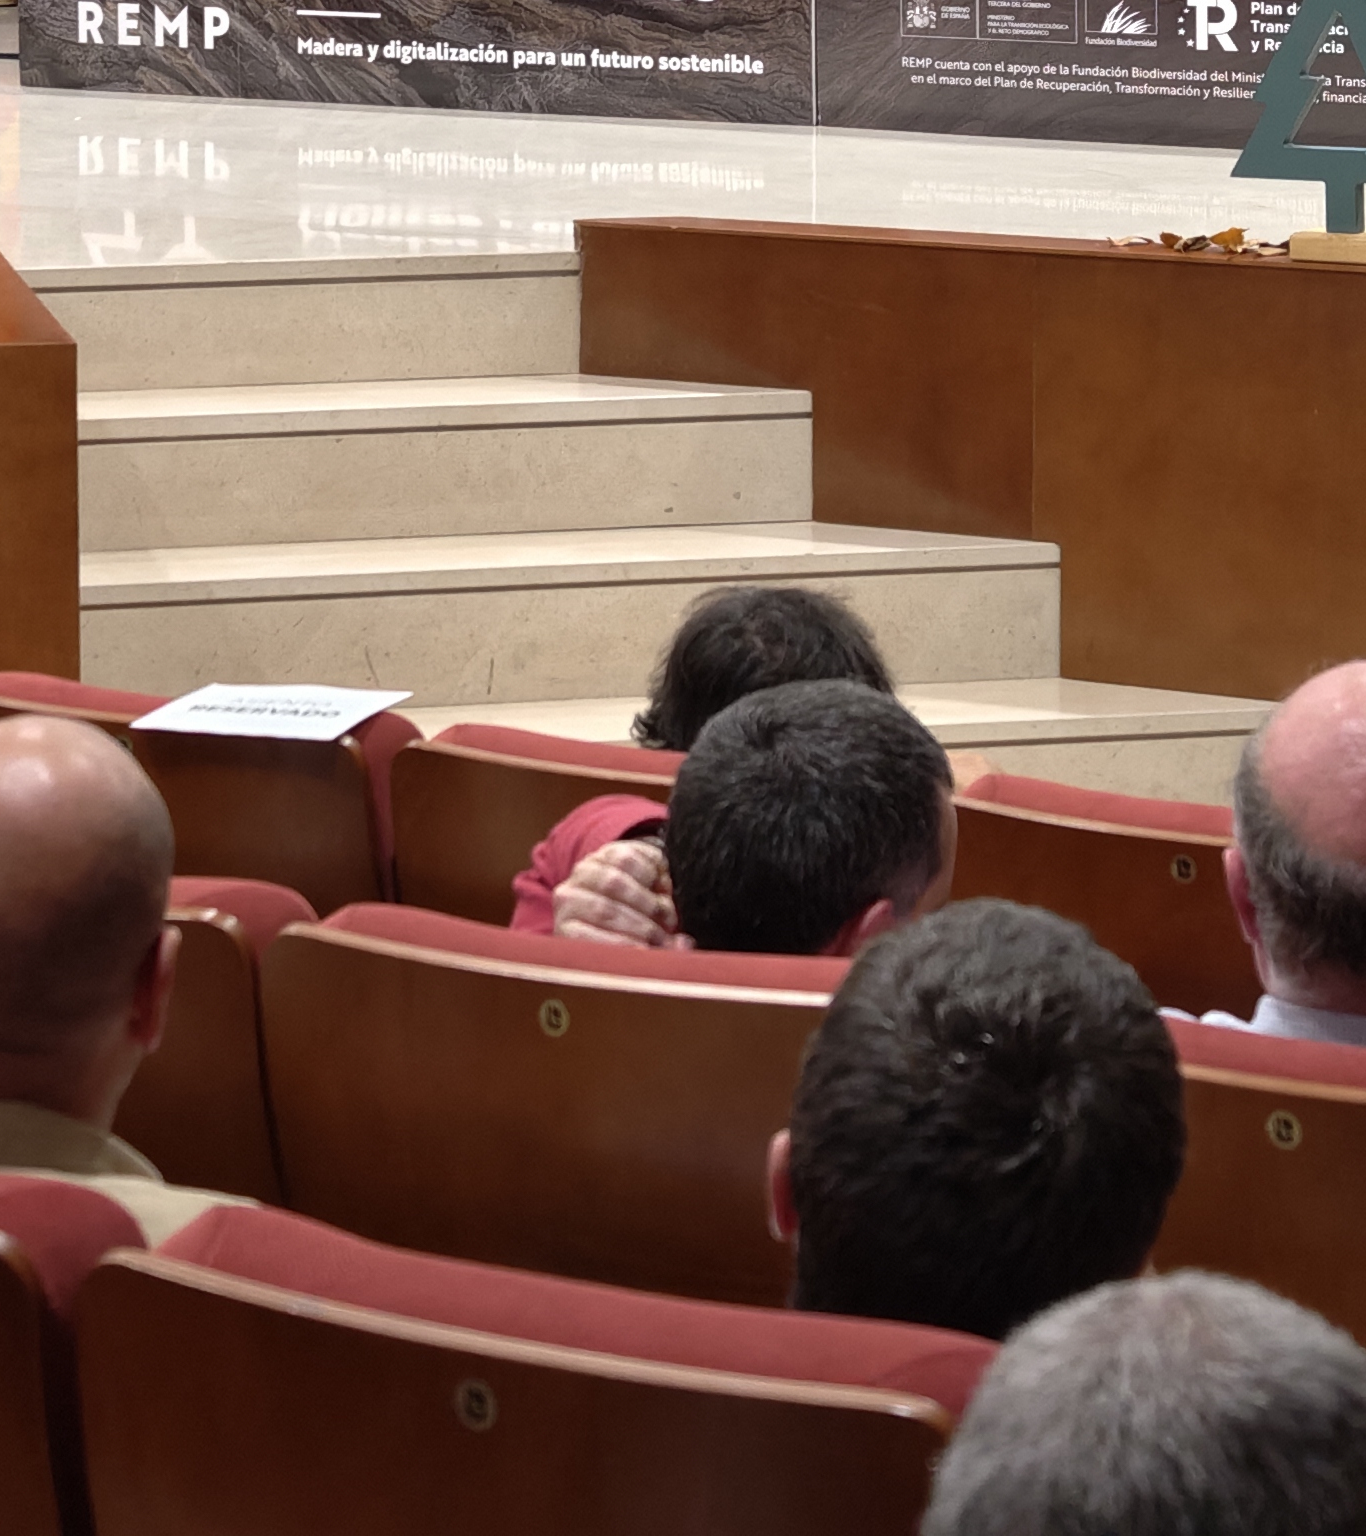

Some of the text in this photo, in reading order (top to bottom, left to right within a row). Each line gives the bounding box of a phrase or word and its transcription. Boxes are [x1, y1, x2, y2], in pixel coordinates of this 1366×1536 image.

[1249, 1, 1283, 16] Plan
[77, 0, 231, 50] REMP
[296, 36, 764, 75] Madera y digitalización para un futuro sostenible
[1250, 40, 1260, 54] y
[901, 56, 932, 69] REMP
[934, 60, 971, 71] cuenta
[972, 61, 992, 72] con
[994, 61, 1005, 73] el
[1007, 64, 1041, 77] apoyo
[1042, 63, 1057, 75] de
[1059, 63, 1070, 75] la
[1072, 64, 1129, 78] Fundación
[1131, 66, 1208, 82] Biodiversidad
[1210, 70, 1229, 83] del
[910, 75, 925, 84] en
[926, 72, 937, 84] el
[939, 76, 972, 87] marco
[974, 74, 992, 87] del
[993, 75, 1017, 88] Plan
[1019, 77, 1034, 89] de
[1035, 78, 1113, 94] Recuperación,
[1115, 81, 1201, 97] Transformación
[1202, 86, 1211, 100] y
[187, 703, 342, 719] RESERVADO
